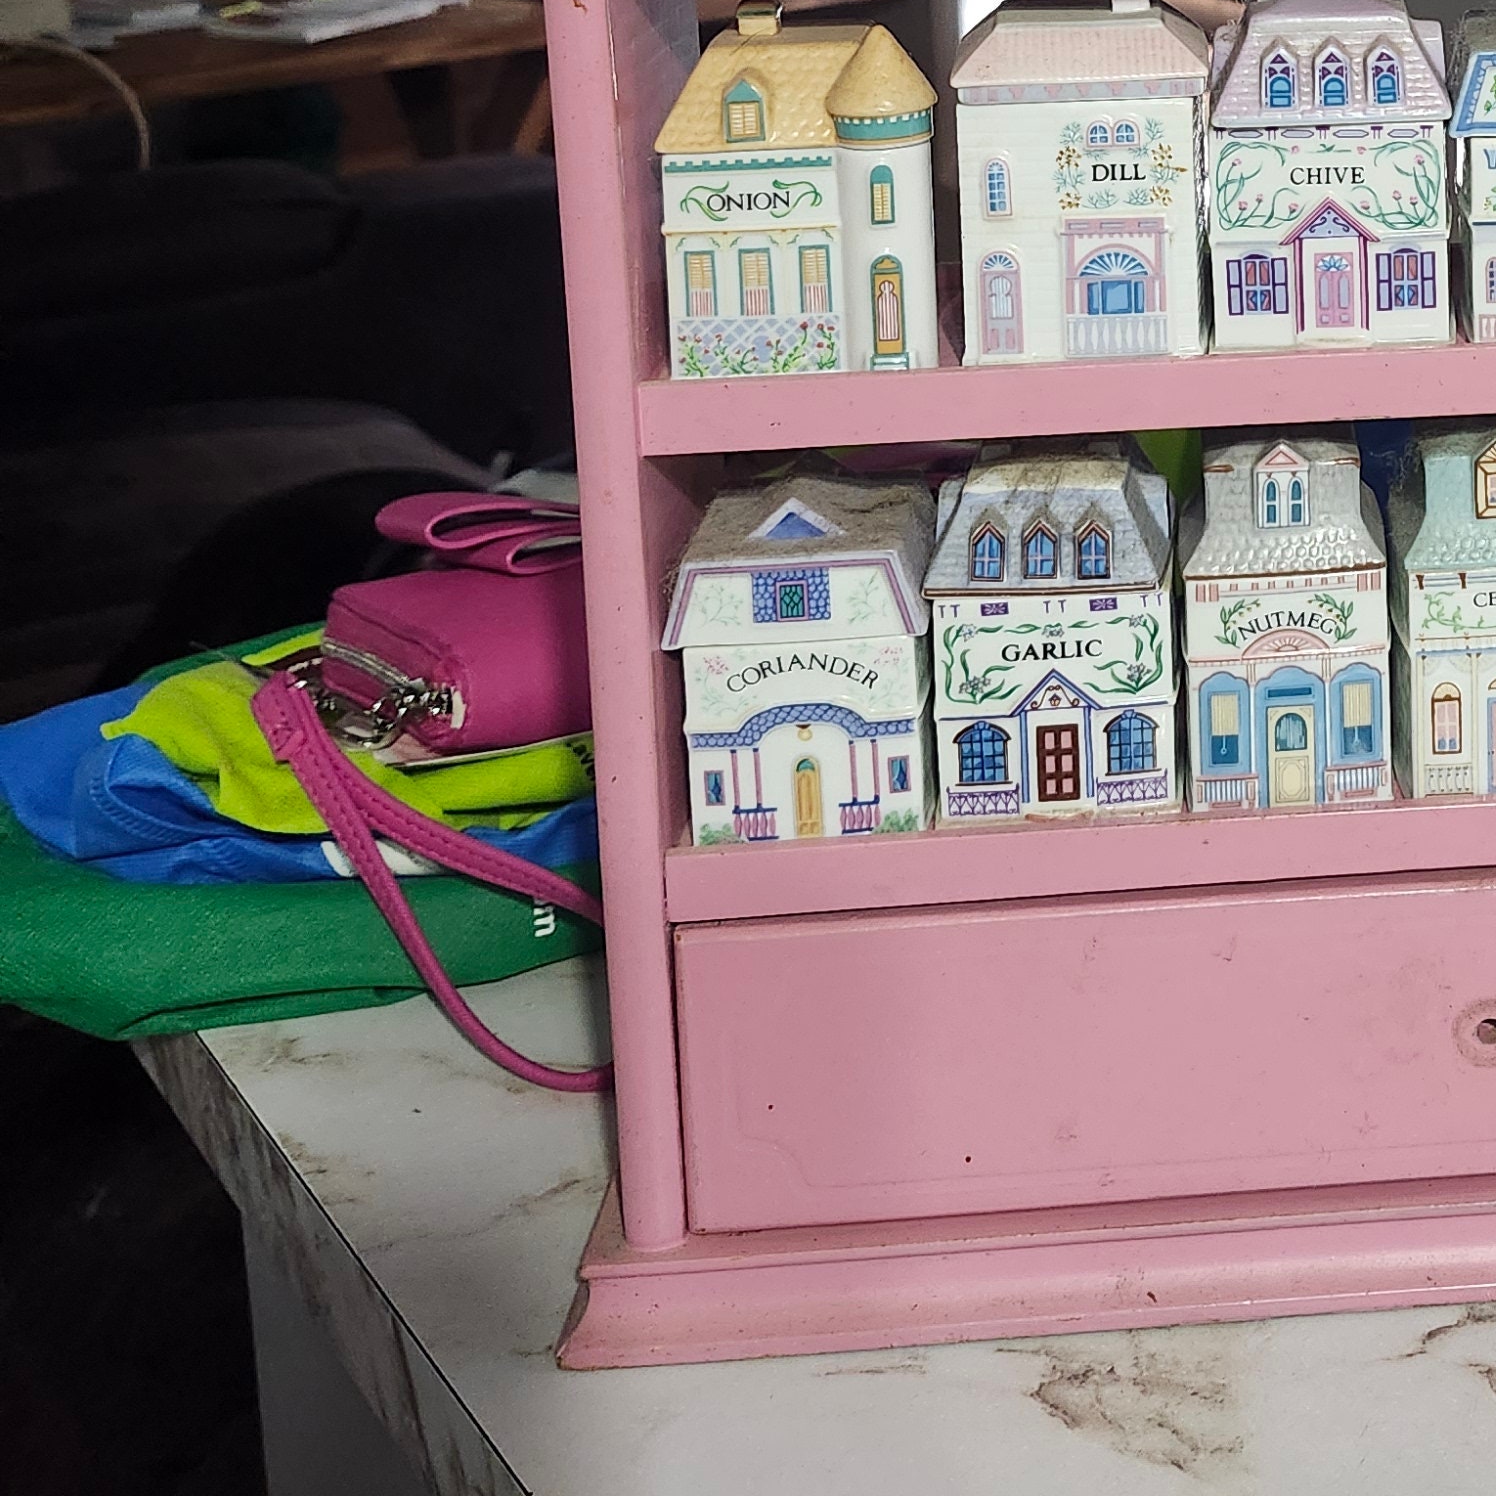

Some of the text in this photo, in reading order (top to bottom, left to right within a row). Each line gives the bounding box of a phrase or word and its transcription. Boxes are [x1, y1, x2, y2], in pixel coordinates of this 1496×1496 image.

[1090, 162, 1147, 183] DILL
[1289, 165, 1366, 186] CHIVE
[706, 191, 791, 213] ONION
[1237, 610, 1338, 642] NUTMEG
[1001, 638, 1104, 663] GARLIC
[725, 652, 881, 693] CORIANDER
